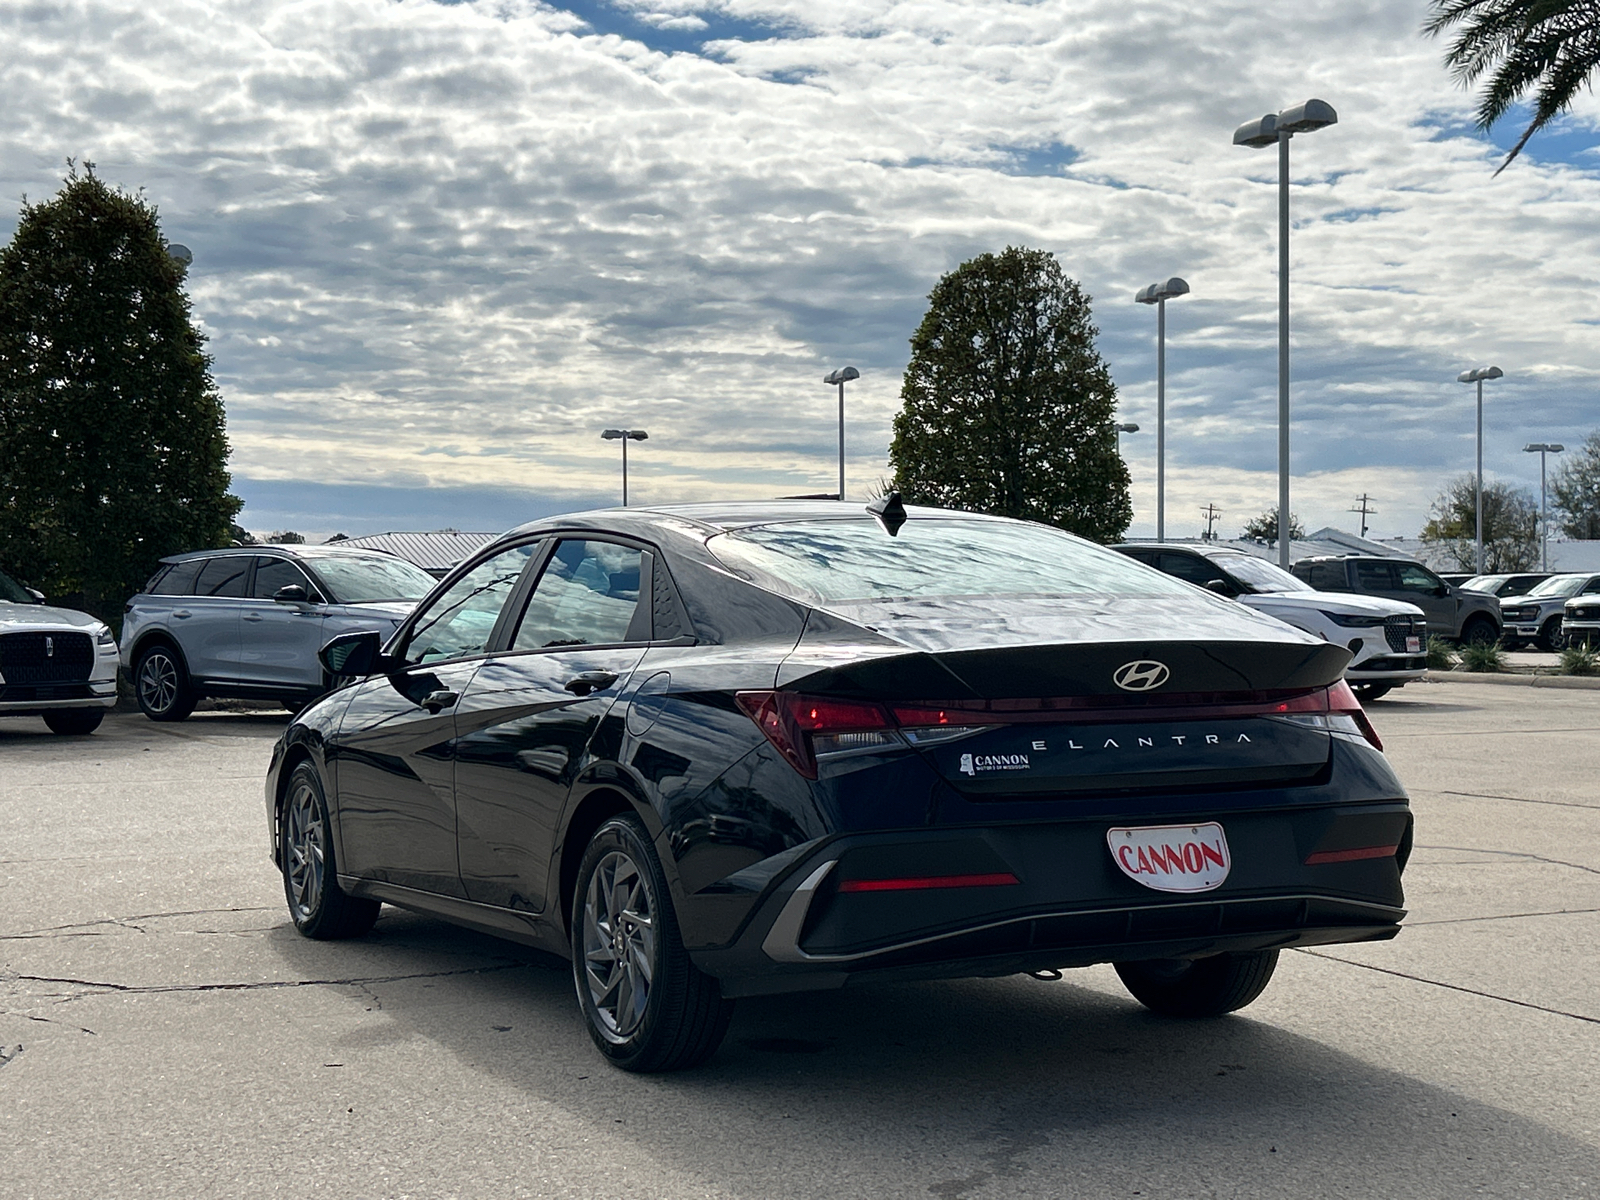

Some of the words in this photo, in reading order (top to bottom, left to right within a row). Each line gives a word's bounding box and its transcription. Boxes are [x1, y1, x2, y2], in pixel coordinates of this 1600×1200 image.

[1031, 733, 1251, 750] ELANTRA
[975, 754, 1029, 766] CANNON
[1118, 840, 1225, 875] CANNON
